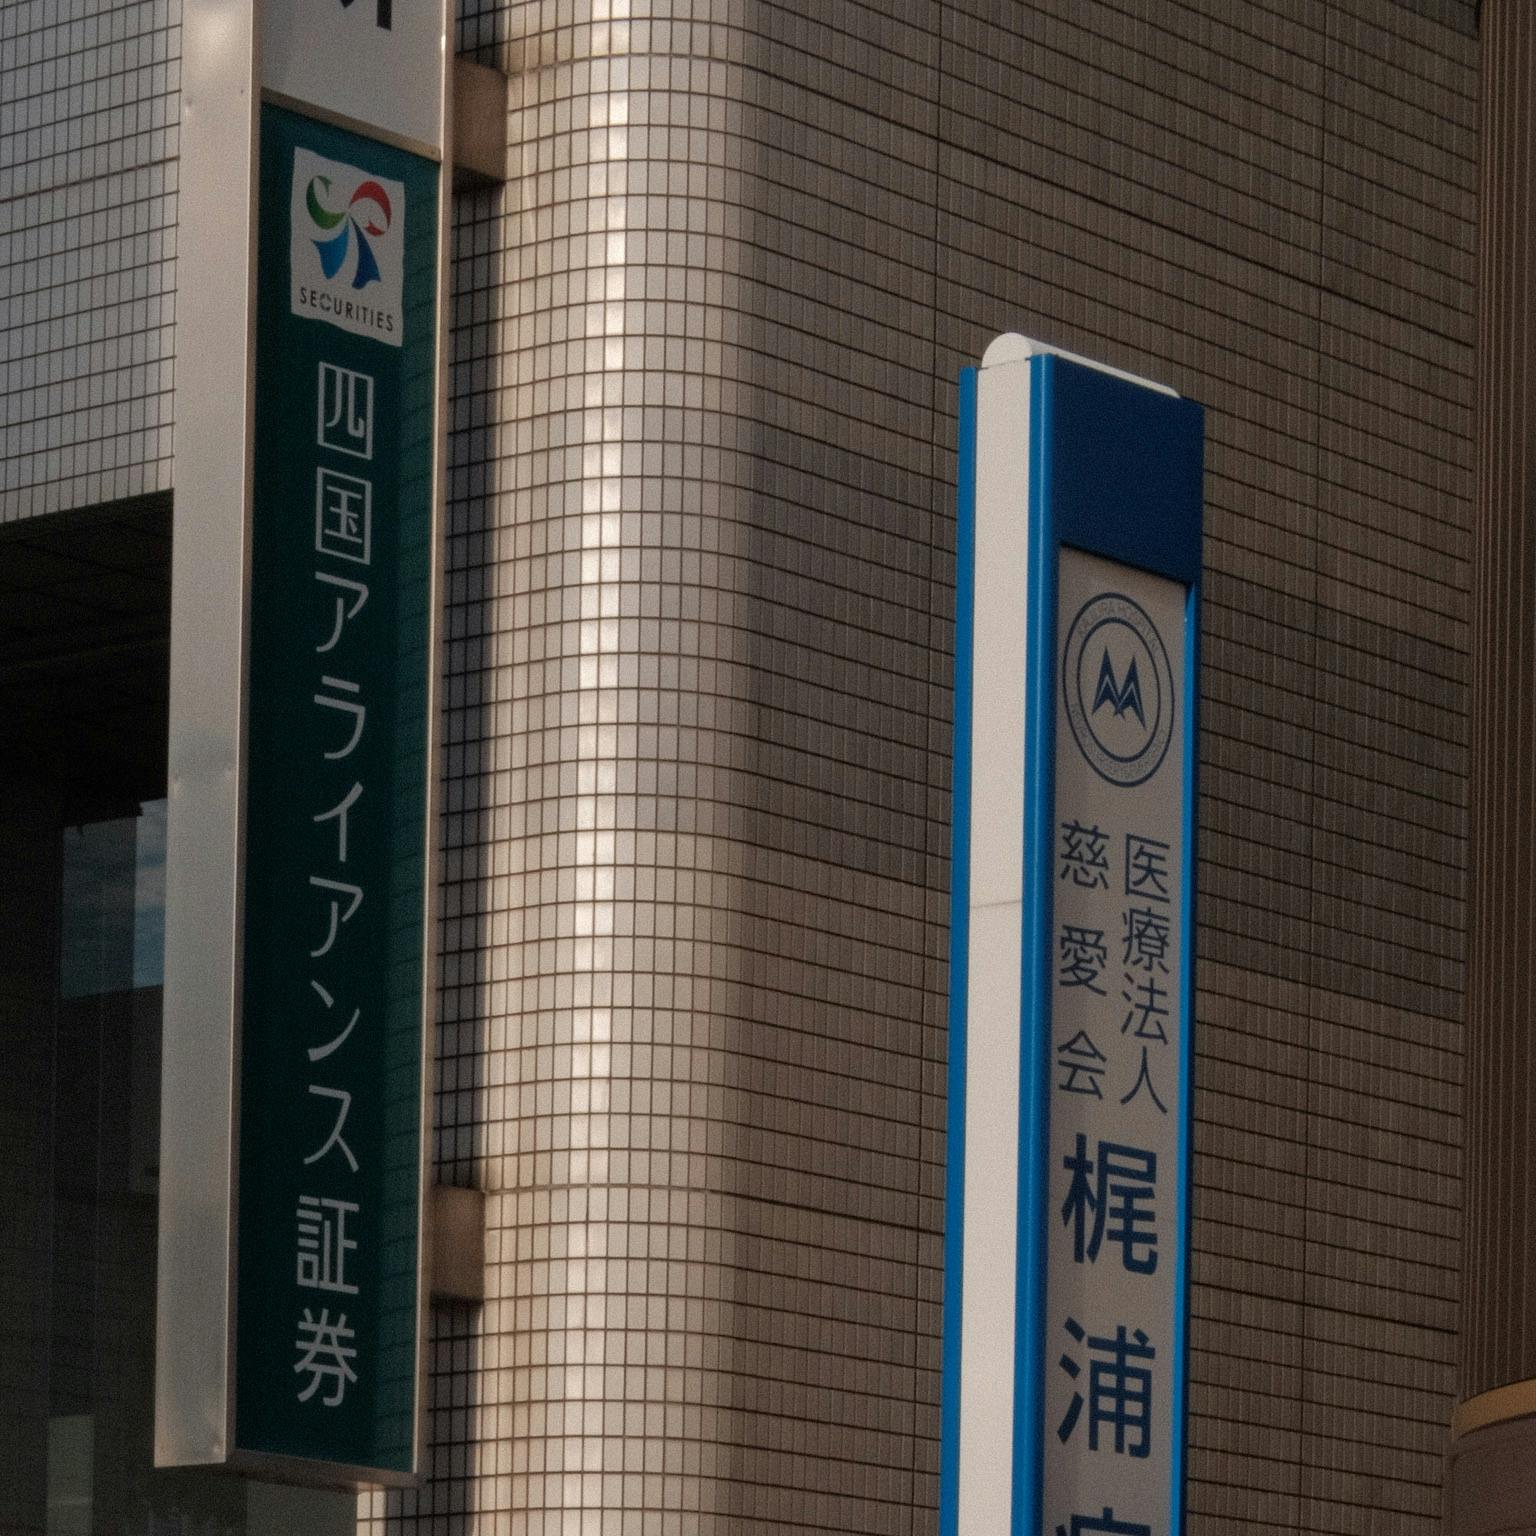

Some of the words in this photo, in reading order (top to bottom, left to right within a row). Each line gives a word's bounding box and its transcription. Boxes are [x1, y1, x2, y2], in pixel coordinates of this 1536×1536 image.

[299, 286, 394, 333] SECURITIES
[293, 360, 375, 1408] 四国アライアンス証券
[1056, 819, 1111, 1101] 慈愛会
[1120, 832, 1171, 1115] 医療法人
